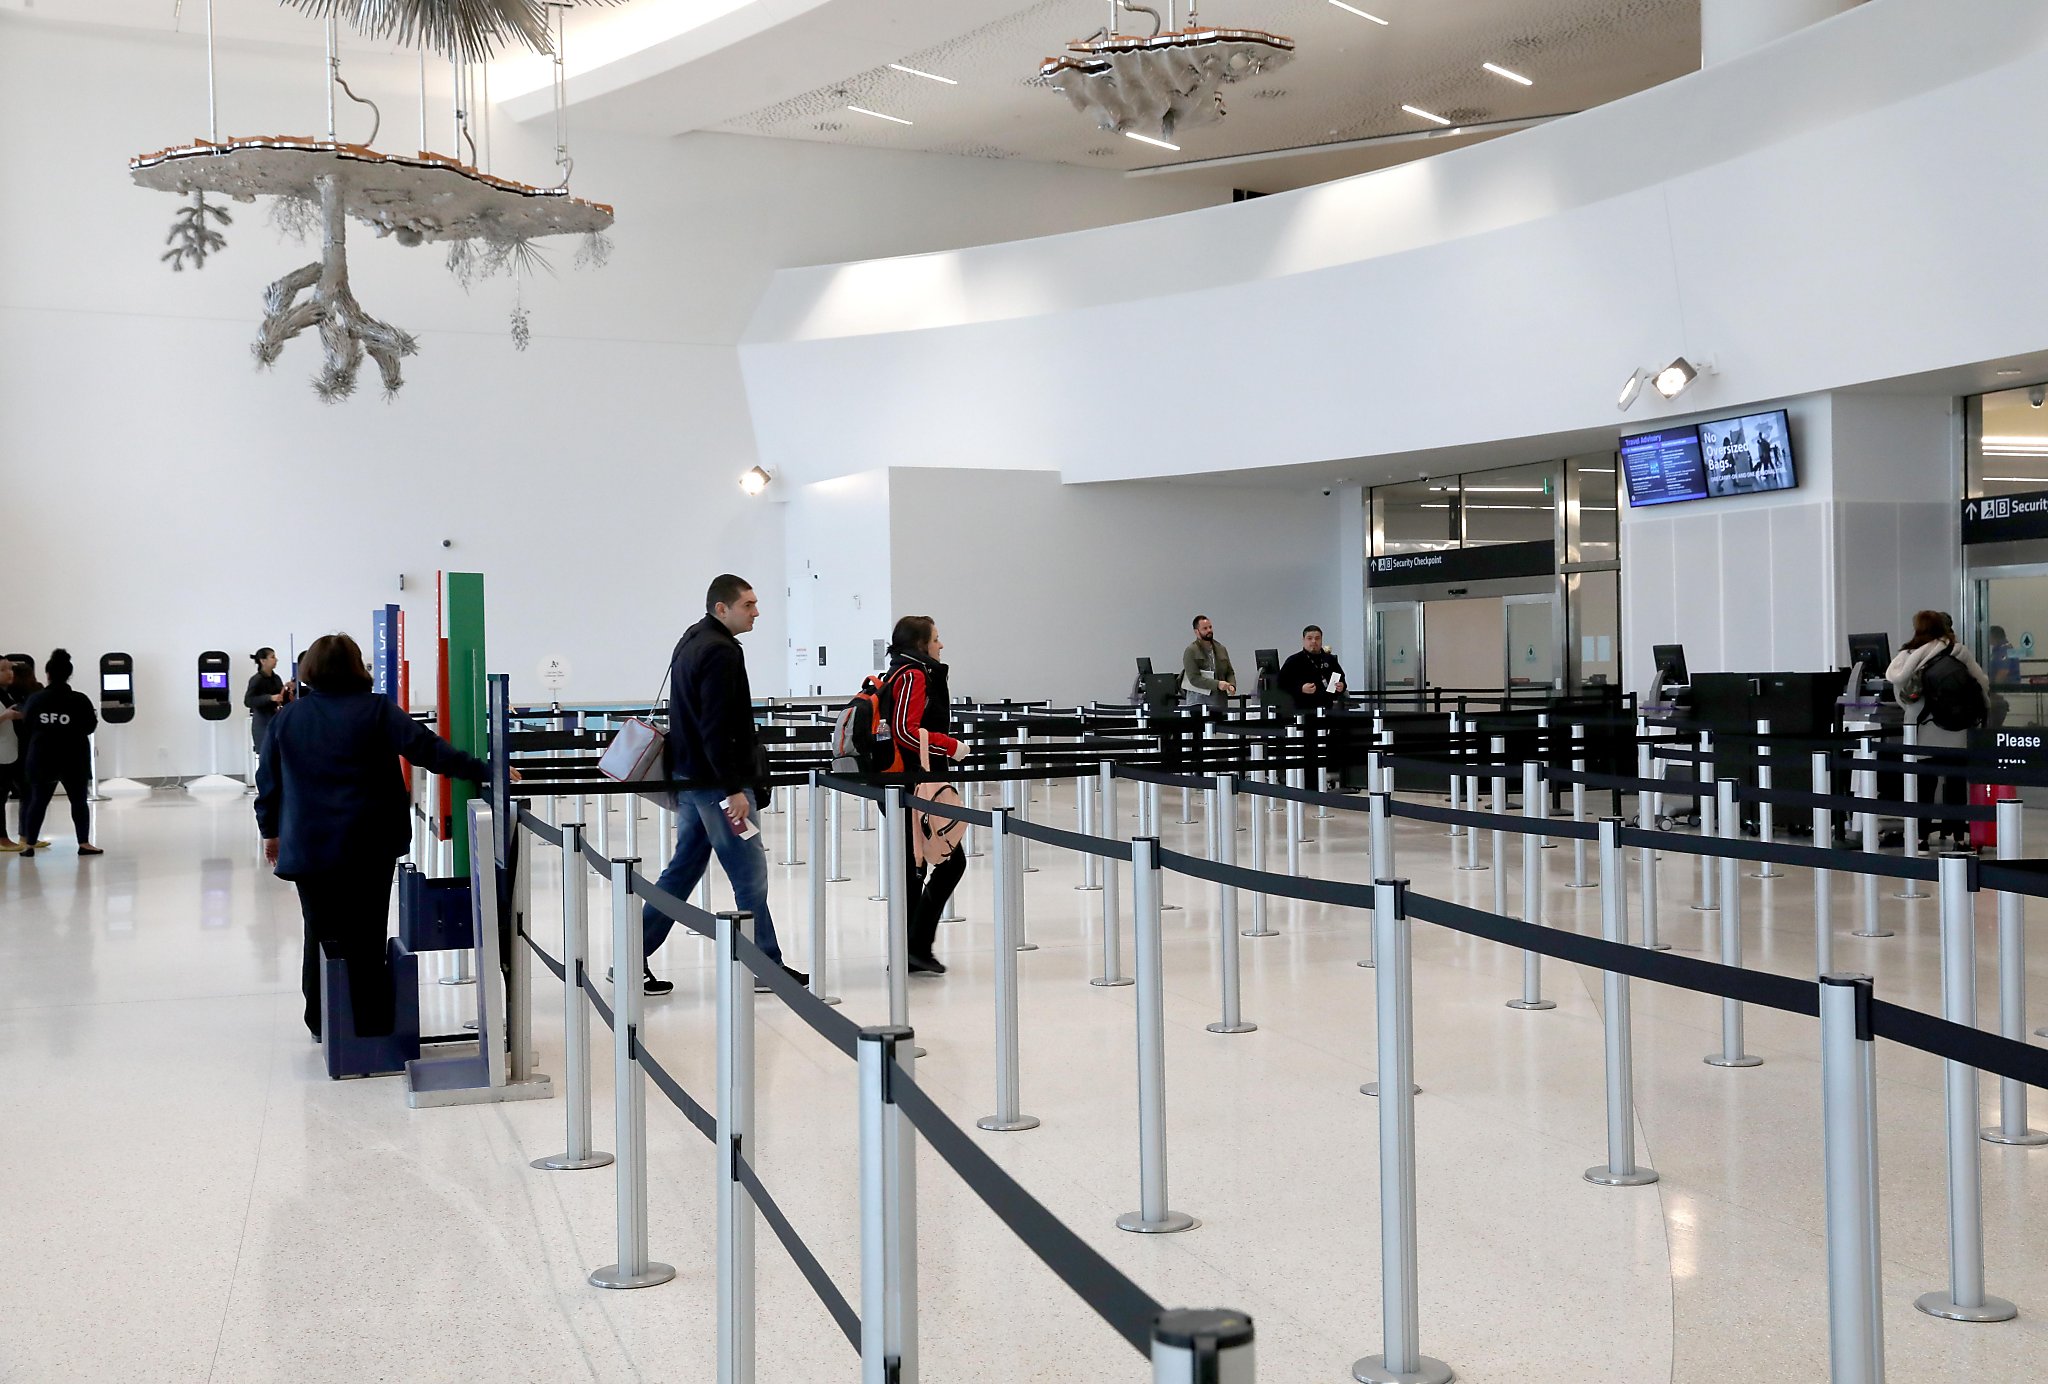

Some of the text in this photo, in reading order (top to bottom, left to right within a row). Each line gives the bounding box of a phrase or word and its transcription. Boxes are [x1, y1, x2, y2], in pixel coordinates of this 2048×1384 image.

[1703, 432, 1717, 444] No
[1706, 442, 1749, 456] Oversized
[1708, 459, 1732, 472] Bags.
[1999, 498, 2048, 514] B Securit
[1393, 558, 1413, 569] Security
[1414, 556, 1442, 567] Checkpoint
[39, 712, 71, 725] SFO
[1996, 733, 2041, 748] Please
